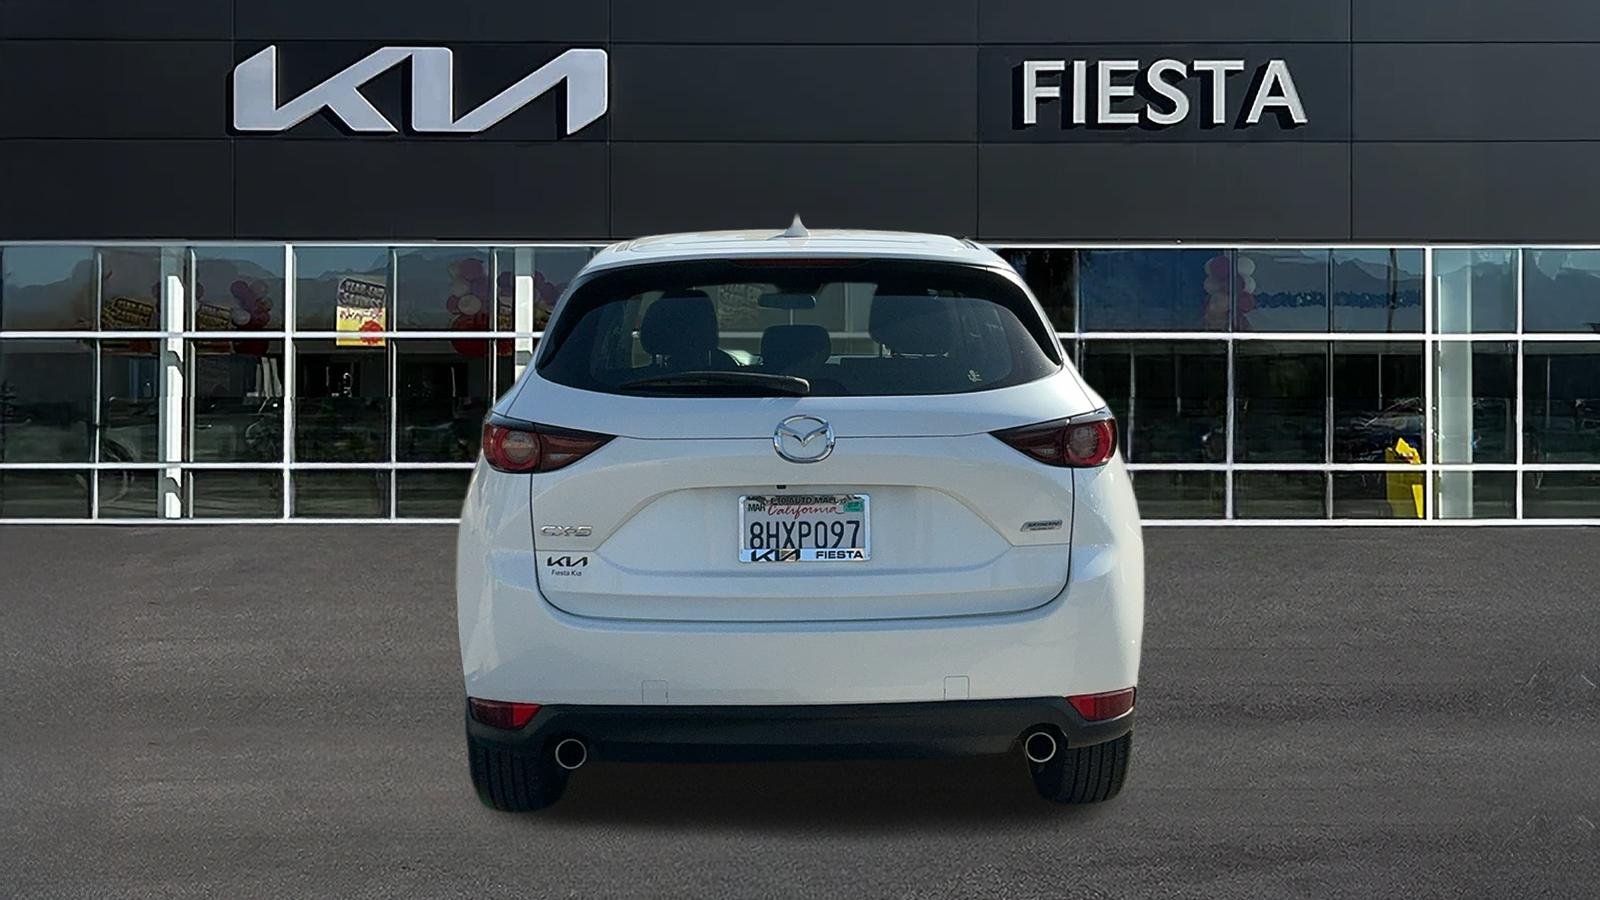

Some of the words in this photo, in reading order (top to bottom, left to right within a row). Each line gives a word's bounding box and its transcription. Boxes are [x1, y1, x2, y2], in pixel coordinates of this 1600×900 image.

[233, 44, 608, 135] KIA
[1023, 58, 1308, 125] FIESTA
[788, 496, 814, 505] AUTO
[747, 503, 766, 512] MAR
[767, 504, 843, 519] California
[541, 526, 592, 536] CX-5
[750, 520, 861, 549] 8HXP097
[547, 556, 588, 567] KIA
[751, 549, 801, 562] KIA
[816, 550, 864, 559] FIESTA
